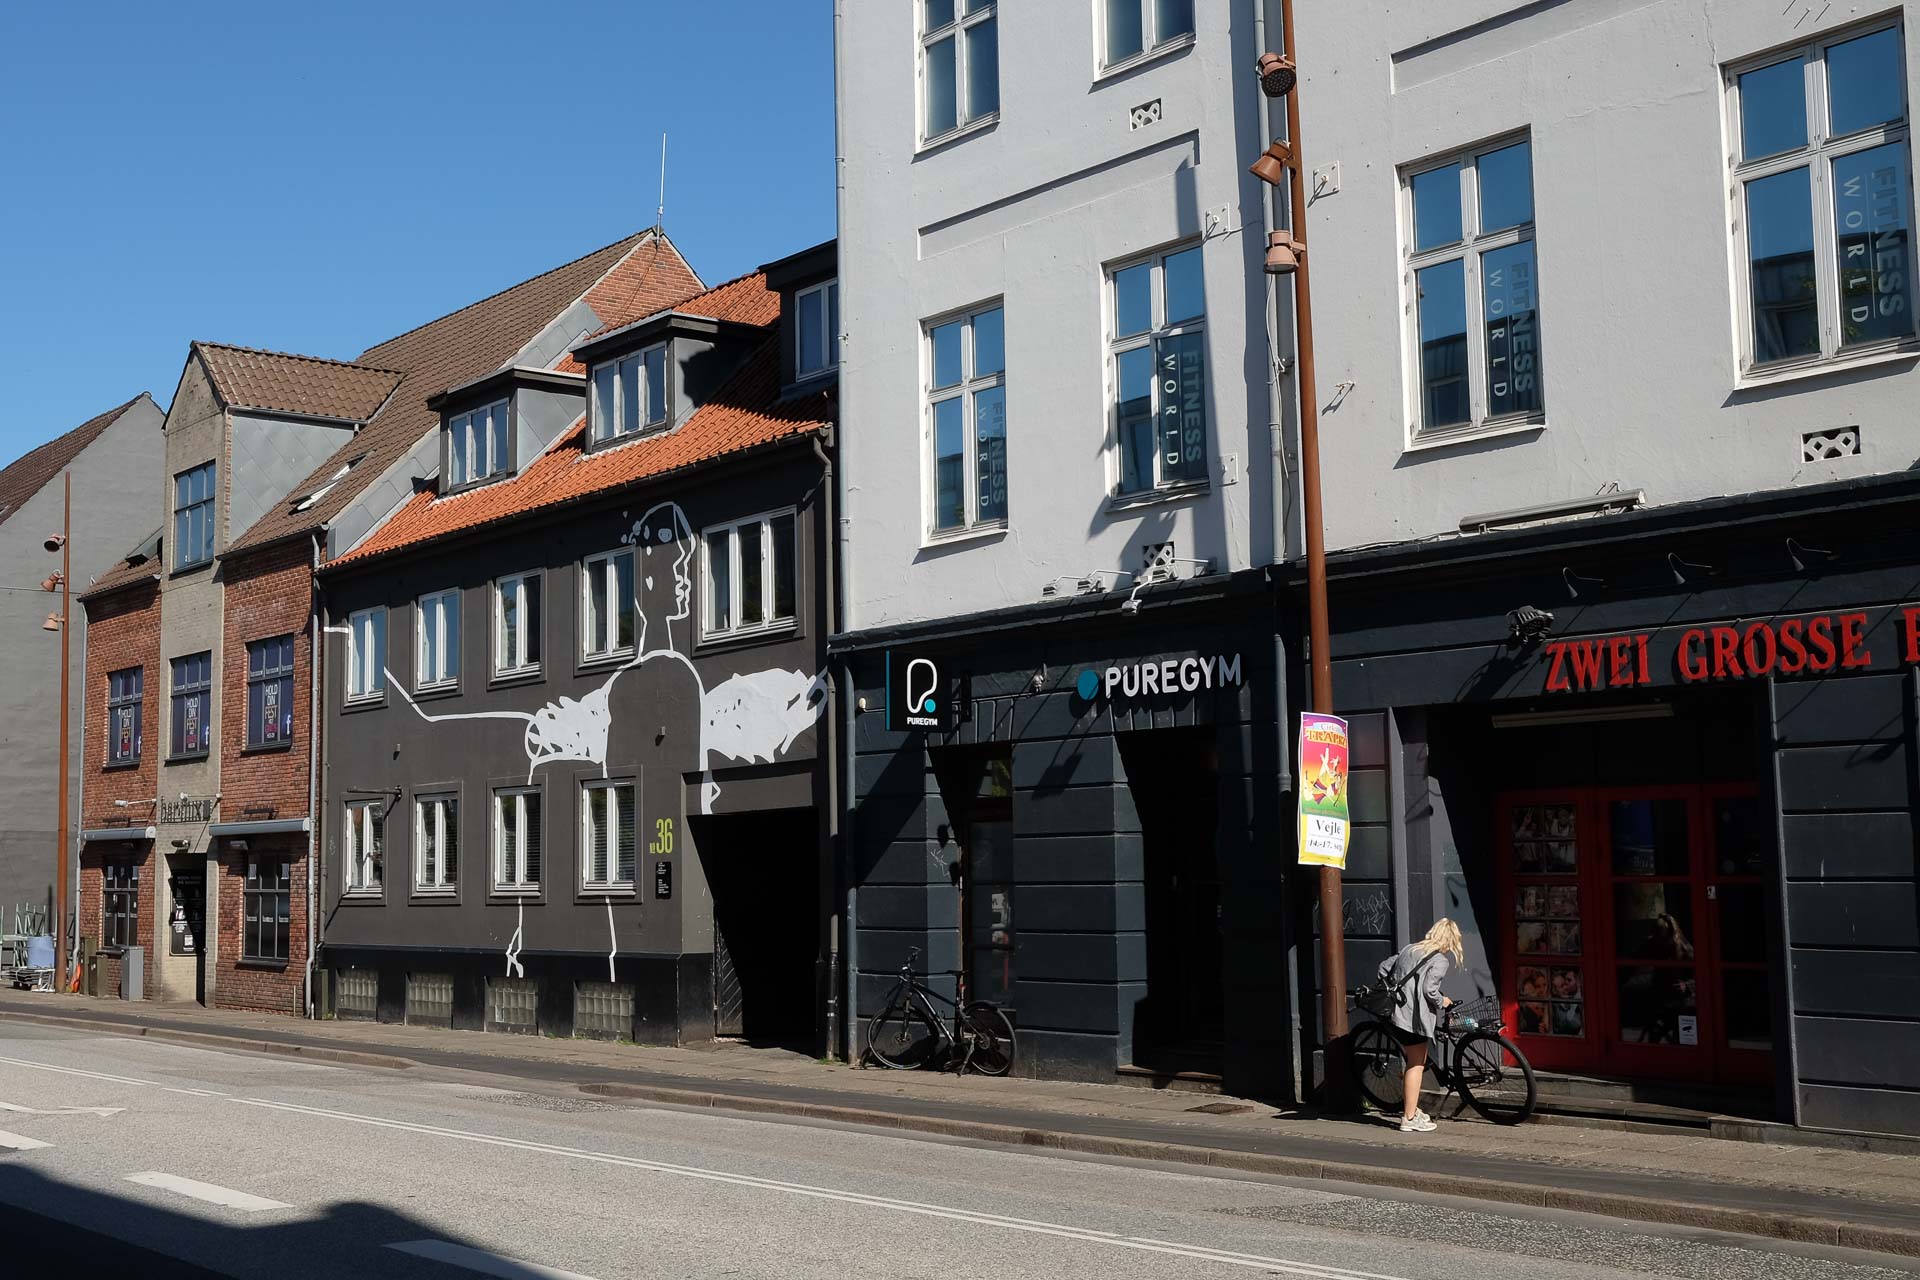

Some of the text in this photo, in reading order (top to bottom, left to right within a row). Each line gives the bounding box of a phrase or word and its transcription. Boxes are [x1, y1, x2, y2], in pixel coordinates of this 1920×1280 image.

[1843, 175, 1869, 323] WORLD
[1872, 166, 1904, 317] FITNESS
[1489, 269, 1507, 397] WORLD
[1511, 262, 1534, 393] FITNESS
[978, 406, 989, 507] WORLD
[991, 401, 1006, 504] FITNESS
[1163, 353, 1179, 465] WORLD
[1183, 350, 1201, 463] FITNESS
[1105, 653, 1242, 699] PUREGYM
[1545, 634, 1650, 691] ZWEI
[1677, 613, 1871, 681] GROSSE
[906, 717, 938, 726] PUREGYM
[656, 818, 673, 853] 36
[1316, 819, 1341, 836] Vejle
